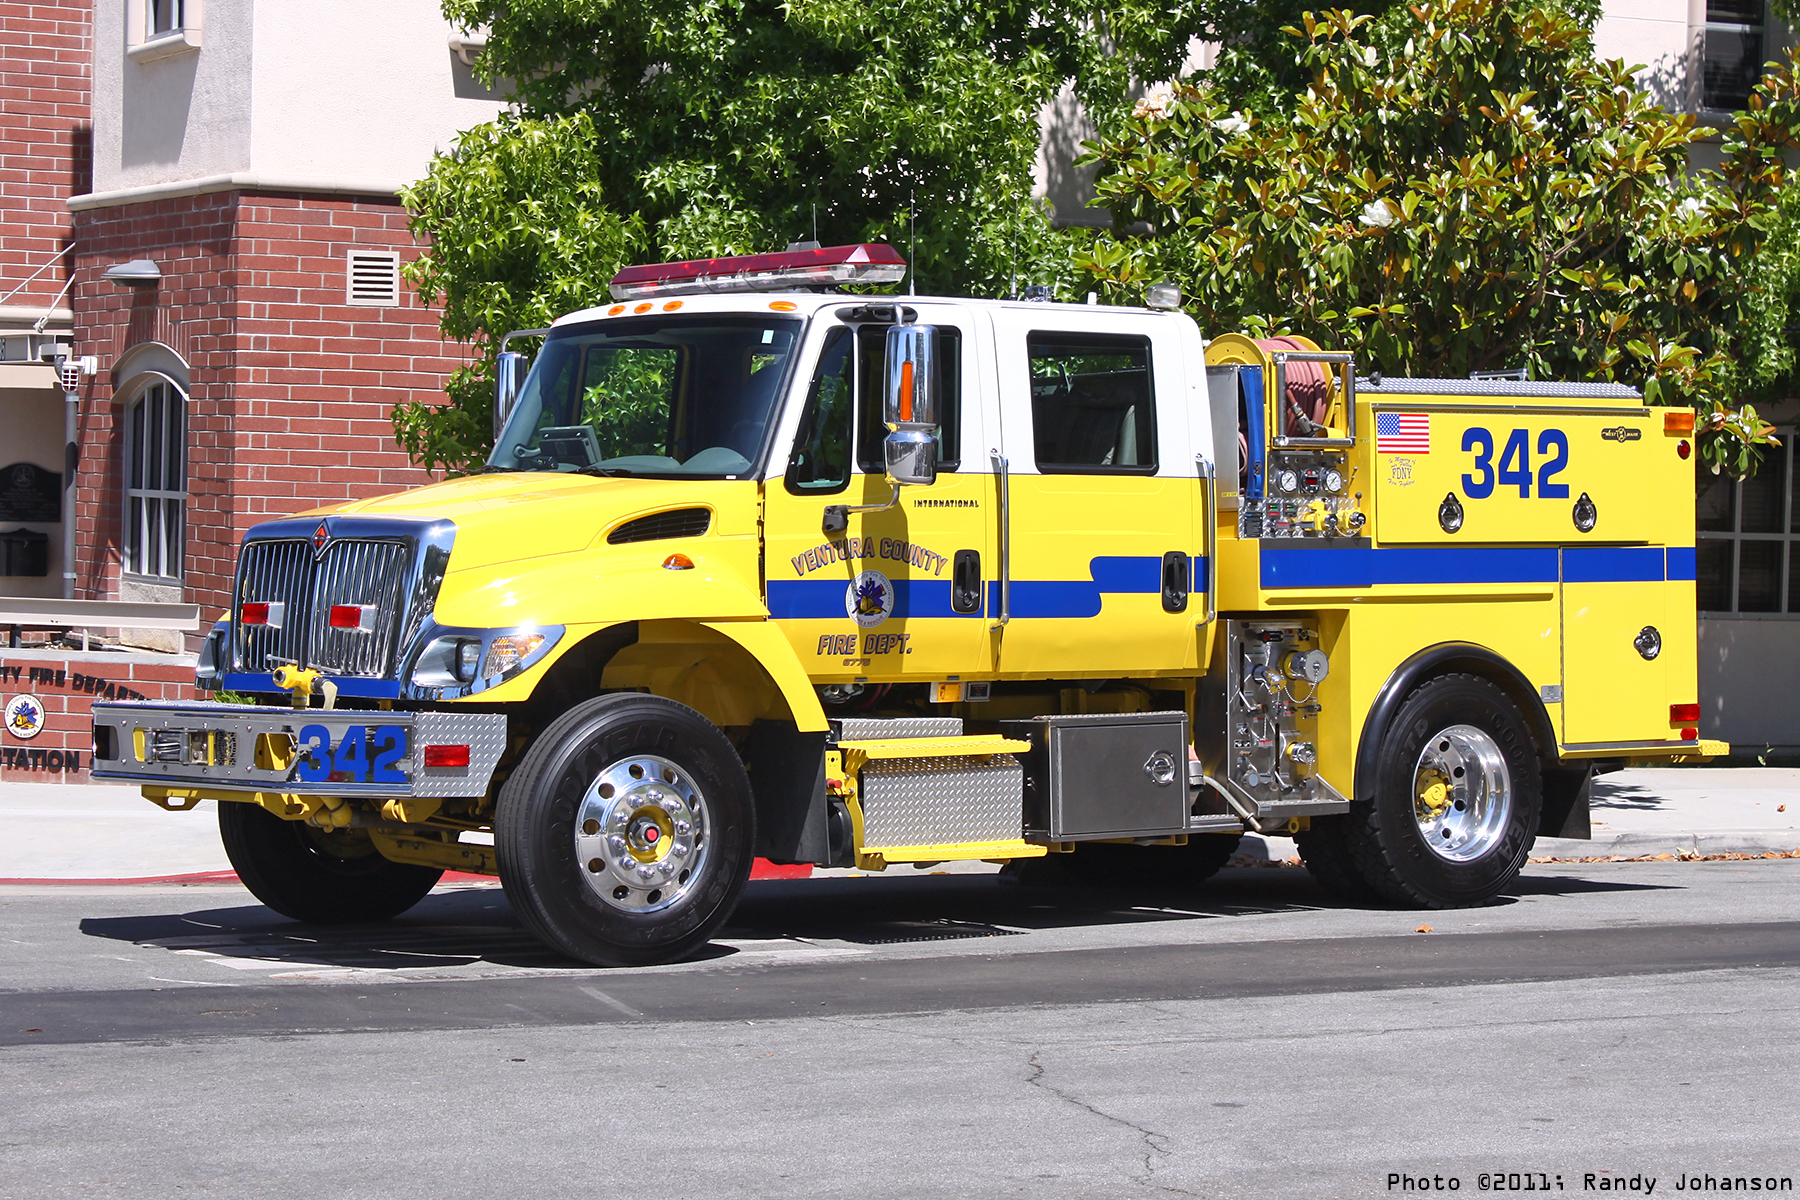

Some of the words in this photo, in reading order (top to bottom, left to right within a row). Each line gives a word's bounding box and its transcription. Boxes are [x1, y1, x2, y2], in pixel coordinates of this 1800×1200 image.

[1392, 467, 1412, 479] FDNY
[1461, 427, 1570, 499] 342
[913, 499, 980, 508] INTERNATIONAL
[791, 537, 876, 577] VENTURA
[879, 537, 949, 577] COUNTY
[817, 634, 858, 656] FIRE
[864, 633, 913, 655] DEPT.
[29, 667, 66, 687] FIRE
[0, 748, 80, 772] TATION
[298, 724, 407, 783] 342
